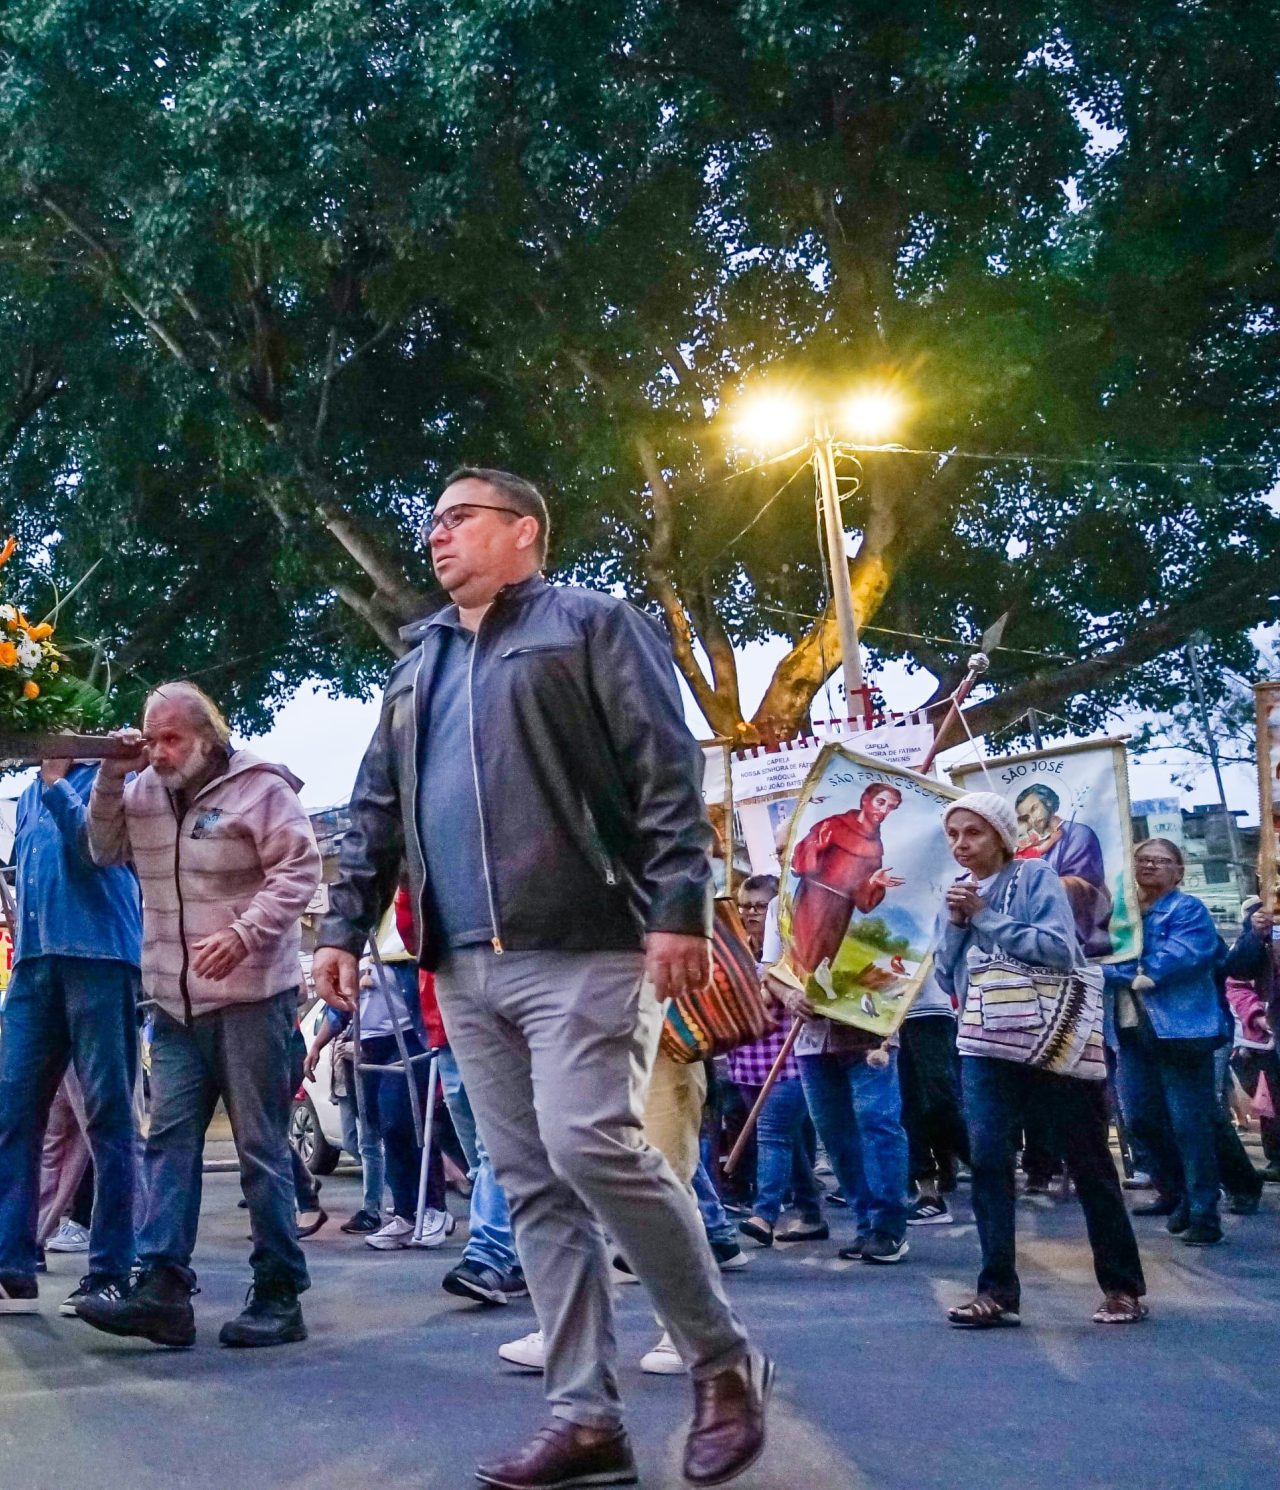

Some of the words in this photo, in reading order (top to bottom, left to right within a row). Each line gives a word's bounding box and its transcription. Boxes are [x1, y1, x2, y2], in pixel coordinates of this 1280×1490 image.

[766, 756, 790, 766] CAPELA
[741, 770, 761, 778] NOSSA
[761, 764, 789, 775] SENHORA
[1001, 765, 1027, 785] SÃO
[1031, 760, 1064, 774] JOSÉ
[768, 781, 785, 790] JOÃO
[828, 773, 854, 787] SÃO
